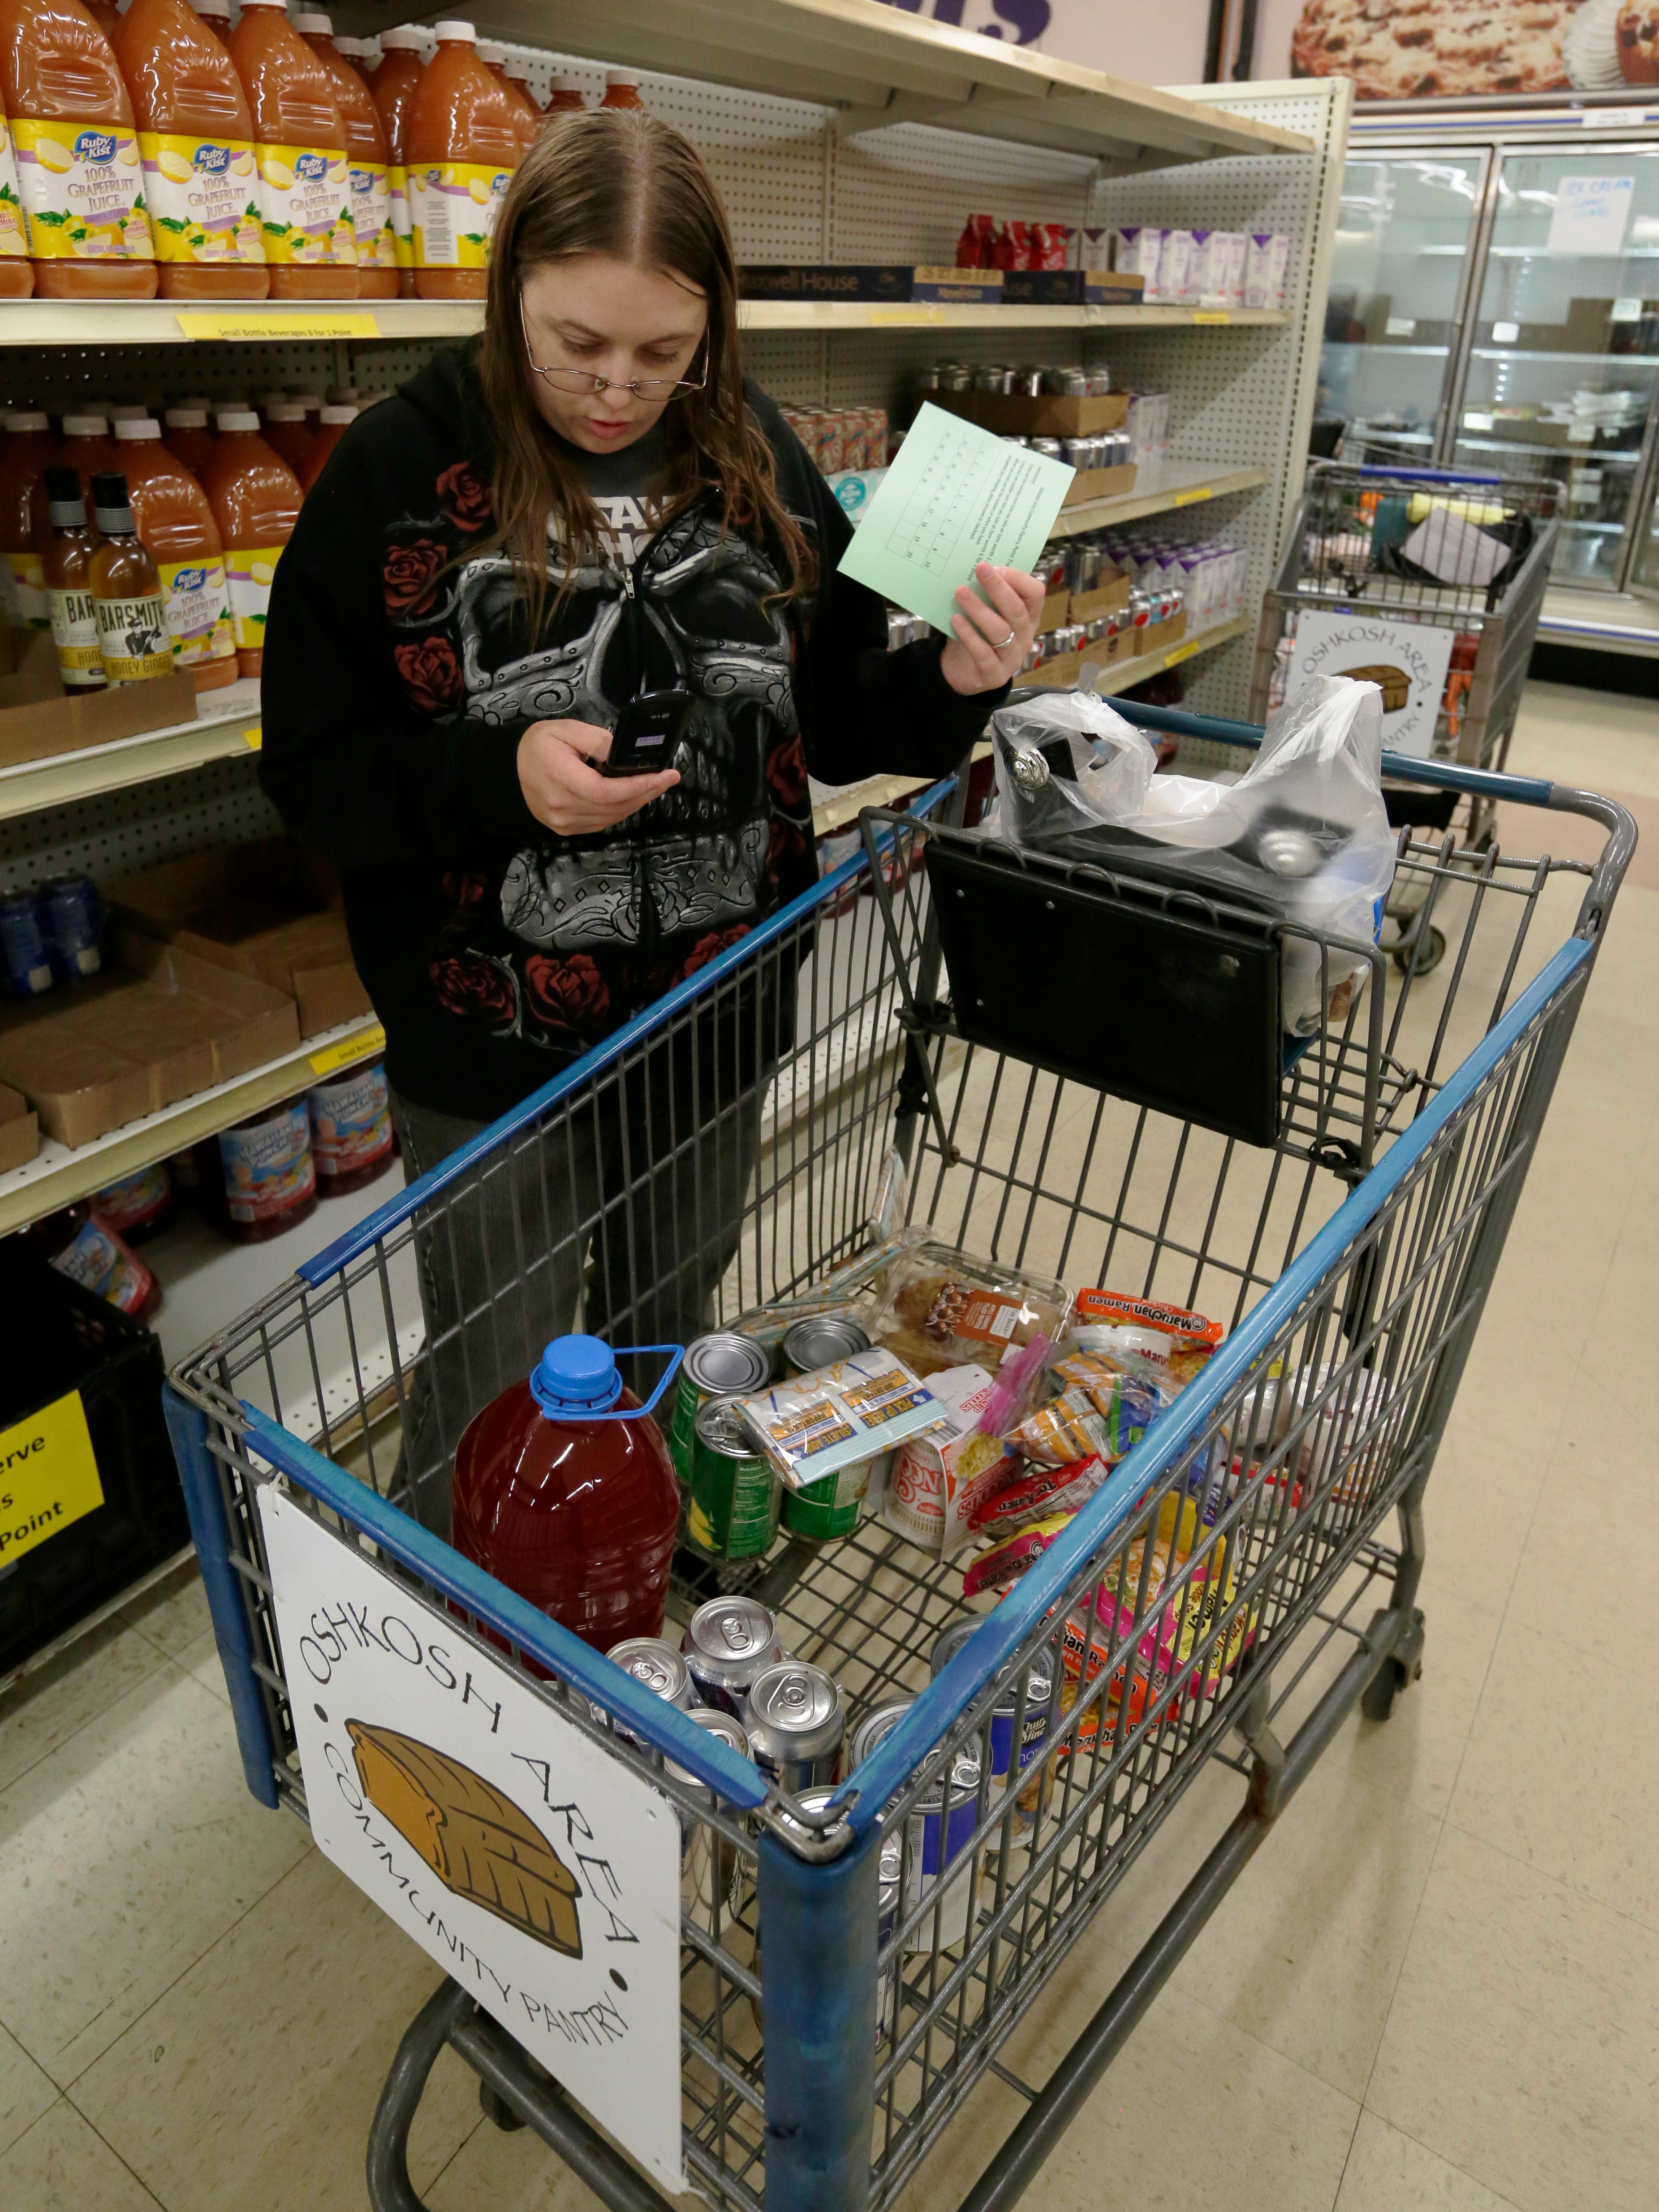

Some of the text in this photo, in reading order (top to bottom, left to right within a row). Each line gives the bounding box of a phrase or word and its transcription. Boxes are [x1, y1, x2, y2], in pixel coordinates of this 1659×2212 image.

[81, 137, 111, 149] Ruby
[89, 146, 111, 158] Kist
[199, 150, 225, 160] Ruby
[206, 157, 225, 169] Kist
[300, 158, 323, 168] Ruby
[85, 166, 116, 181] 100%
[306, 166, 323, 177] Kist
[68, 179, 134, 198] GRAPEFRUIT
[203, 176, 229, 190] 100%
[89, 194, 121, 213] JUICE
[188, 188, 246, 206] GRAPEFRUIT
[206, 203, 235, 220] JUICE
[802, 272, 859, 291] House
[1015, 530, 1025, 545] Pantry
[980, 539, 990, 553] worth
[988, 543, 998, 557] worth
[1009, 545, 1019, 558] Point
[905, 551, 913, 559] 20
[923, 560, 931, 568] 10
[1302, 626, 1432, 692] OSHKOSH AREA
[110, 661, 139, 677] HONEY
[1088, 1295, 1192, 1330] Maruchan Ramen
[1000, 1308, 1017, 1337] THE BAKERY
[885, 1405, 897, 1418] UP
[897, 1397, 915, 1412] PICK
[973, 1399, 991, 1413] CUP
[862, 1410, 887, 1427] HERE!
[995, 1488, 1037, 1519] Ramen
[0, 1501, 63, 1552] Point
[300, 1602, 640, 1944] OSHKOSH AREA
[323, 1742, 629, 2046] COMMUNITY PANTRY
